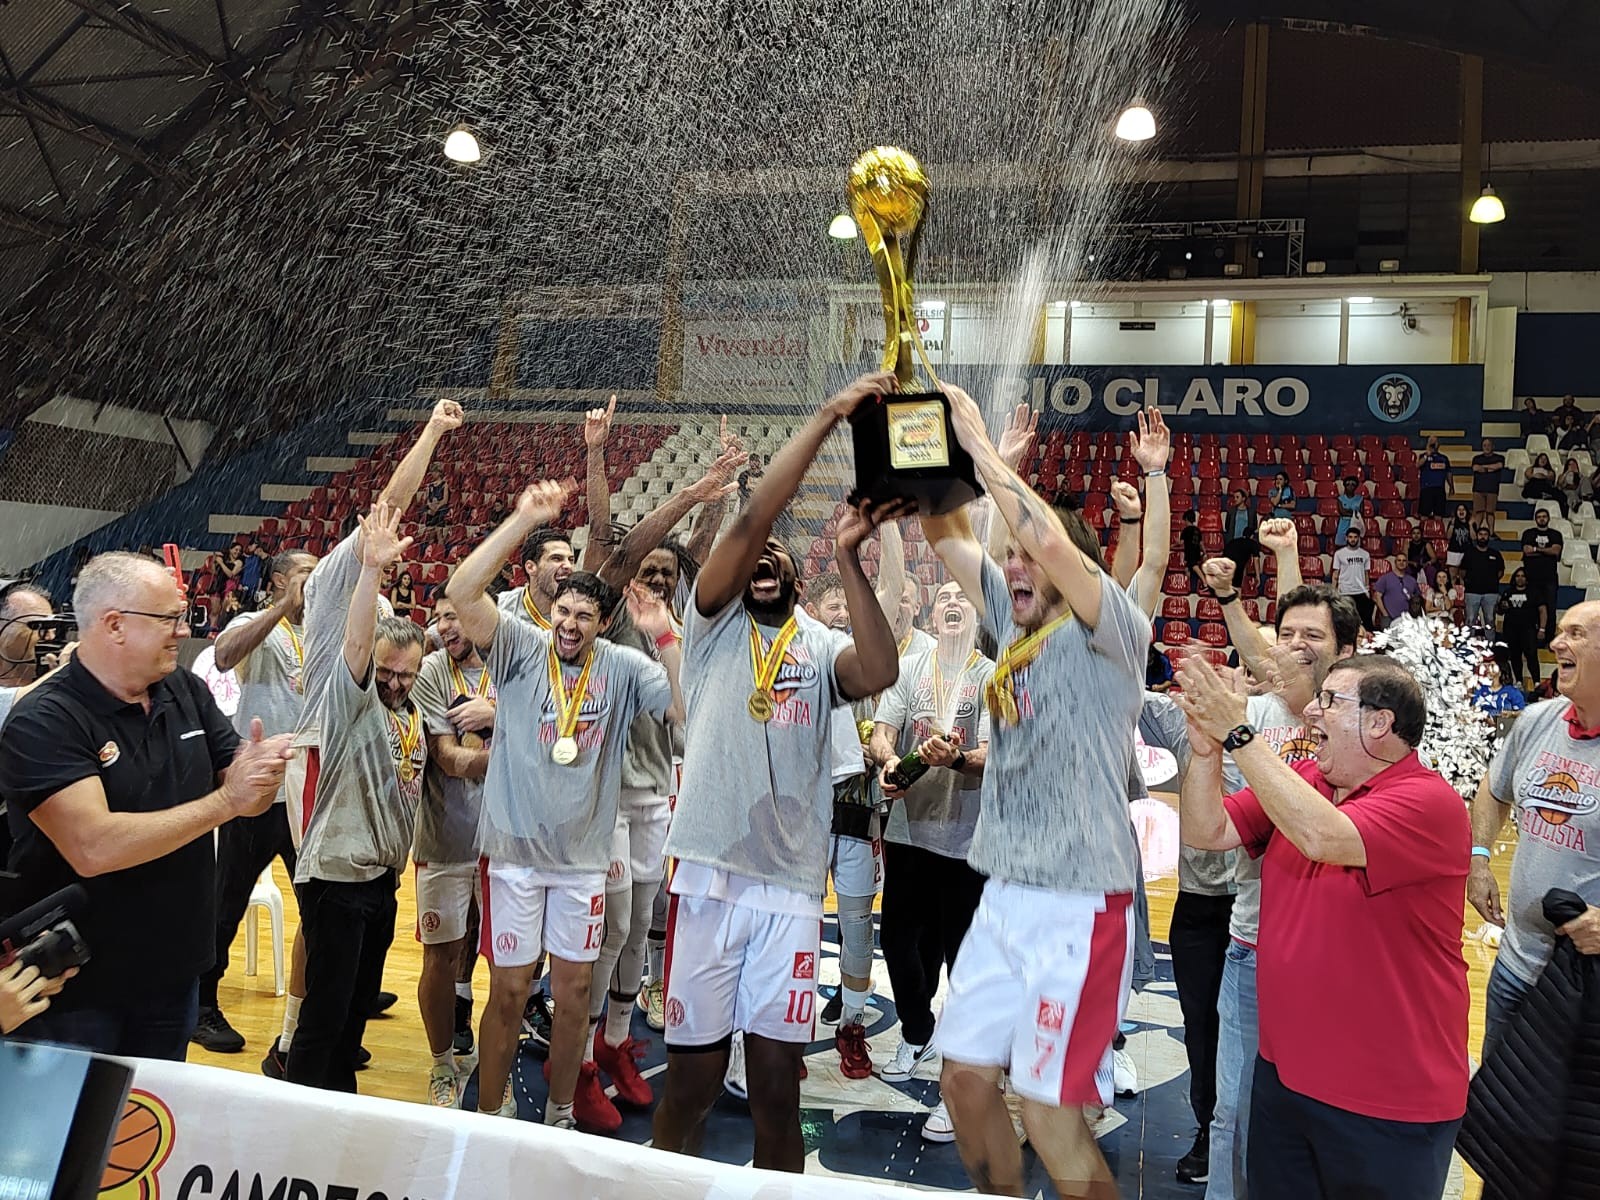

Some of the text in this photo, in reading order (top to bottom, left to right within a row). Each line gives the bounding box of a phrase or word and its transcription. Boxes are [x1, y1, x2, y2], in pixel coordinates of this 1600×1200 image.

[992, 378, 1310, 416] RIO CLARO
[583, 922, 602, 950] 13
[783, 990, 813, 1025] 10
[1029, 1033, 1056, 1080] 7
